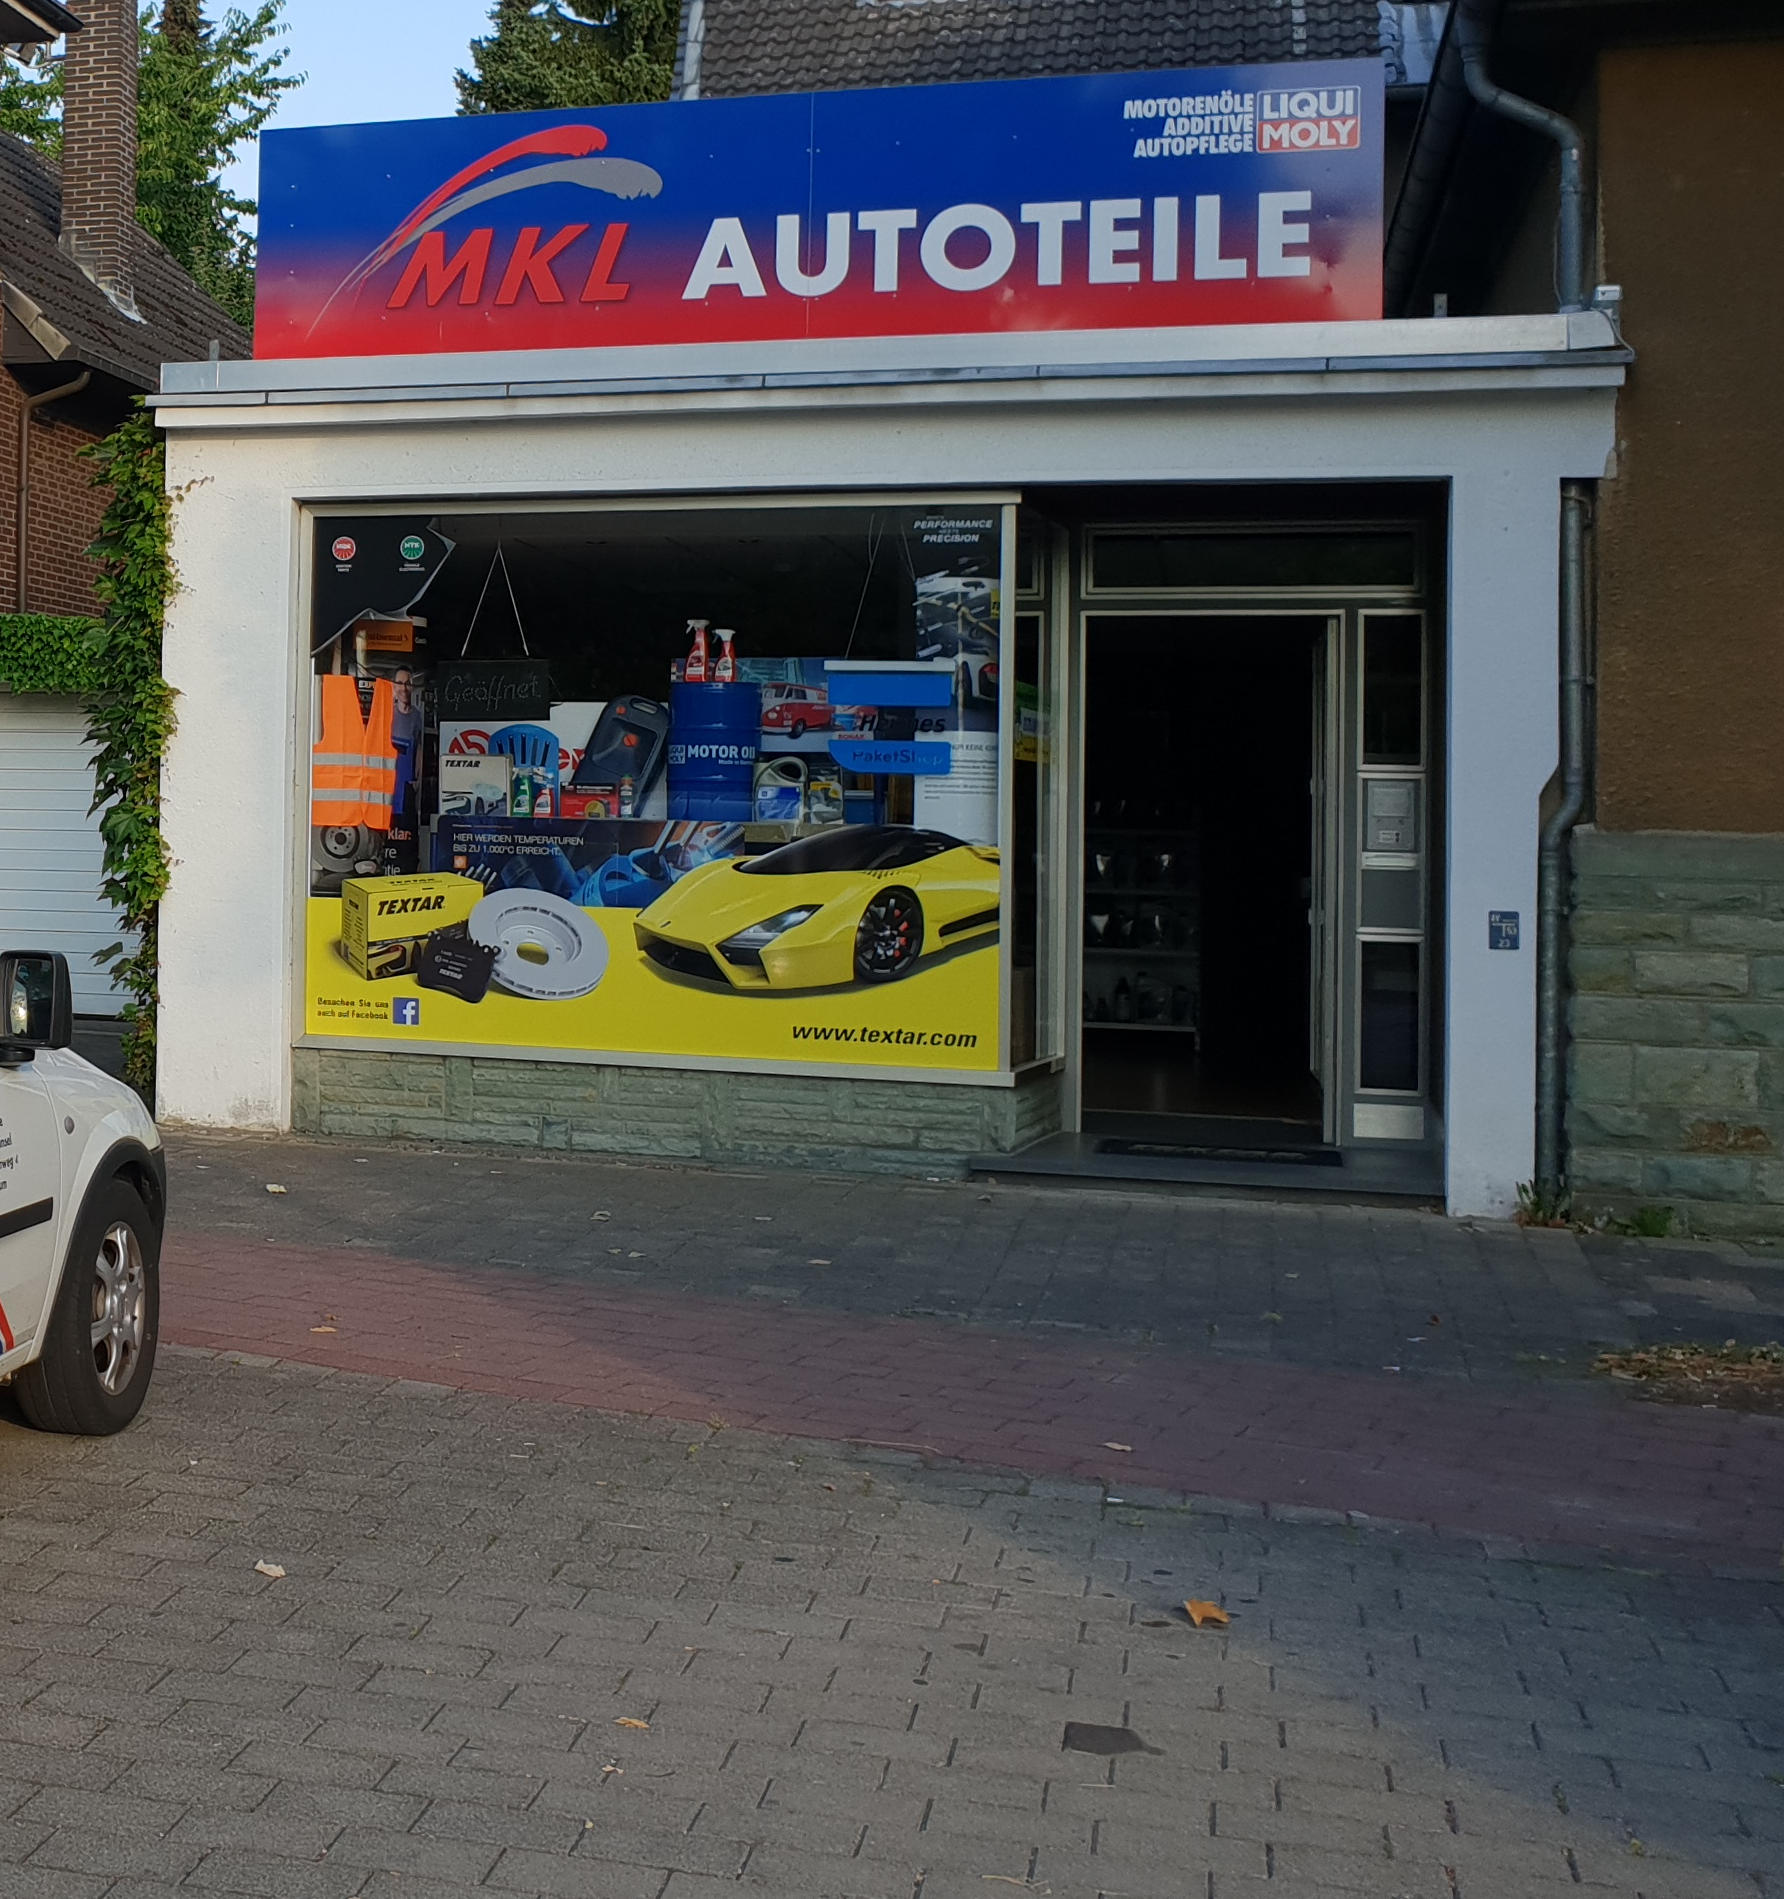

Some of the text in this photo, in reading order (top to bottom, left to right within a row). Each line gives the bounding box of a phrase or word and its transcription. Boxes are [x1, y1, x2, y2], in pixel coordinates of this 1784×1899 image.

[1123, 89, 1254, 119] MOTORENÖLE
[1262, 90, 1355, 119] LIQUI
[1162, 114, 1253, 136] ADDITIVE
[1262, 119, 1356, 149] MOLY
[1133, 134, 1253, 158] AUTOPFLEGE
[385, 190, 1312, 309] MKL AUTOTEILE
[913, 519, 993, 529] PERFORMANCE
[922, 534, 980, 543] PRECISION
[859, 714, 946, 733] Heres
[687, 744, 738, 759] MOTOR
[445, 759, 481, 768] TEXTAR
[453, 833, 584, 846] HIER WERDEN TEMPERATUREN
[377, 895, 445, 917] TEXTAR
[792, 1023, 977, 1048] www.textar.com
